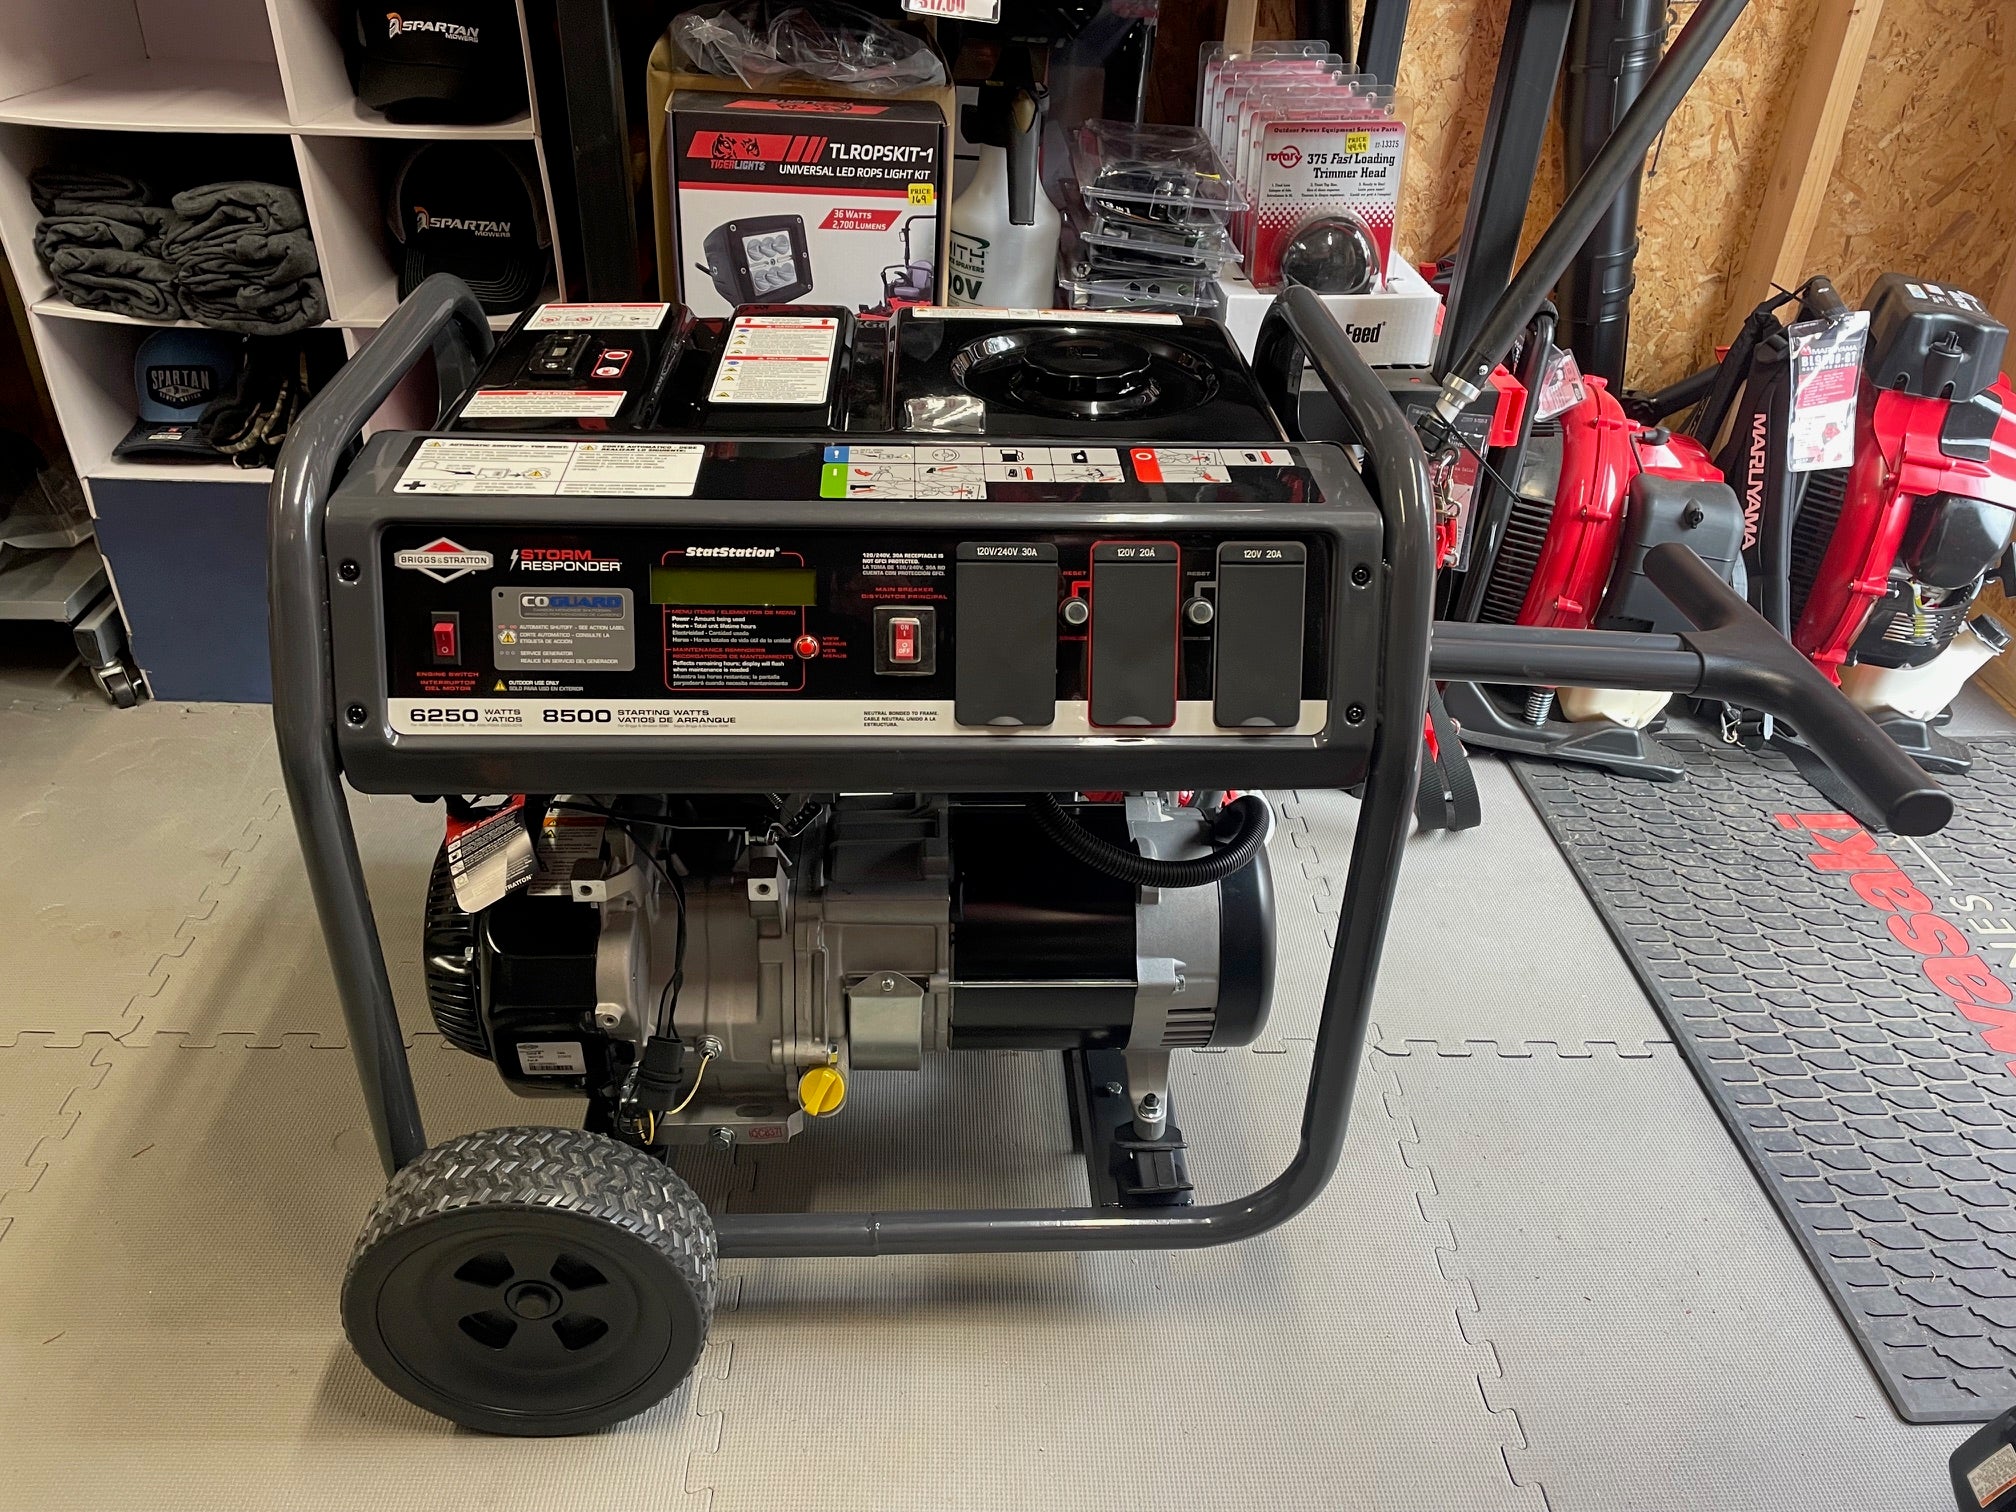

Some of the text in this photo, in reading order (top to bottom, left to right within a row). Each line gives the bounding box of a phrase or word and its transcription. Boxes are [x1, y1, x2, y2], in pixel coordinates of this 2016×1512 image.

[402, 21, 479, 37] SPARTAN
[445, 32, 478, 43] MOWERS
[830, 143, 934, 163] TLROPSKIT-1
[1267, 150, 1302, 162] rotary
[710, 160, 766, 171] TIGERLIGHTS
[1307, 153, 1395, 166] 375 Fast Loading
[779, 164, 931, 180] UNIVERSAL LED ROPS LIGHT KIT
[1314, 167, 1386, 179] Trimmer Head
[912, 195, 927, 204] 169
[834, 210, 872, 219] 36 WATTS
[430, 218, 511, 232] SPARTAN
[832, 220, 886, 230] 2,700 LUMENS
[475, 230, 511, 238] MOWERS
[950, 240, 985, 266] ITH
[956, 260, 985, 273] SPRAYERS
[1346, 324, 1382, 343] Feed
[151, 370, 210, 390] SPARTAN
[1742, 414, 1767, 551] MARUYAMA
[521, 549, 592, 560] STORM
[686, 547, 775, 558] StatStation
[977, 547, 1038, 556] 120V/240V 30A
[1117, 549, 1155, 557] 120V 20A
[1244, 550, 1282, 558] 120V 20A
[521, 561, 620, 572] RESPONDER
[410, 709, 478, 723] 6250
[543, 709, 612, 723] 8500
[505, 874, 532, 891] TRATTON
